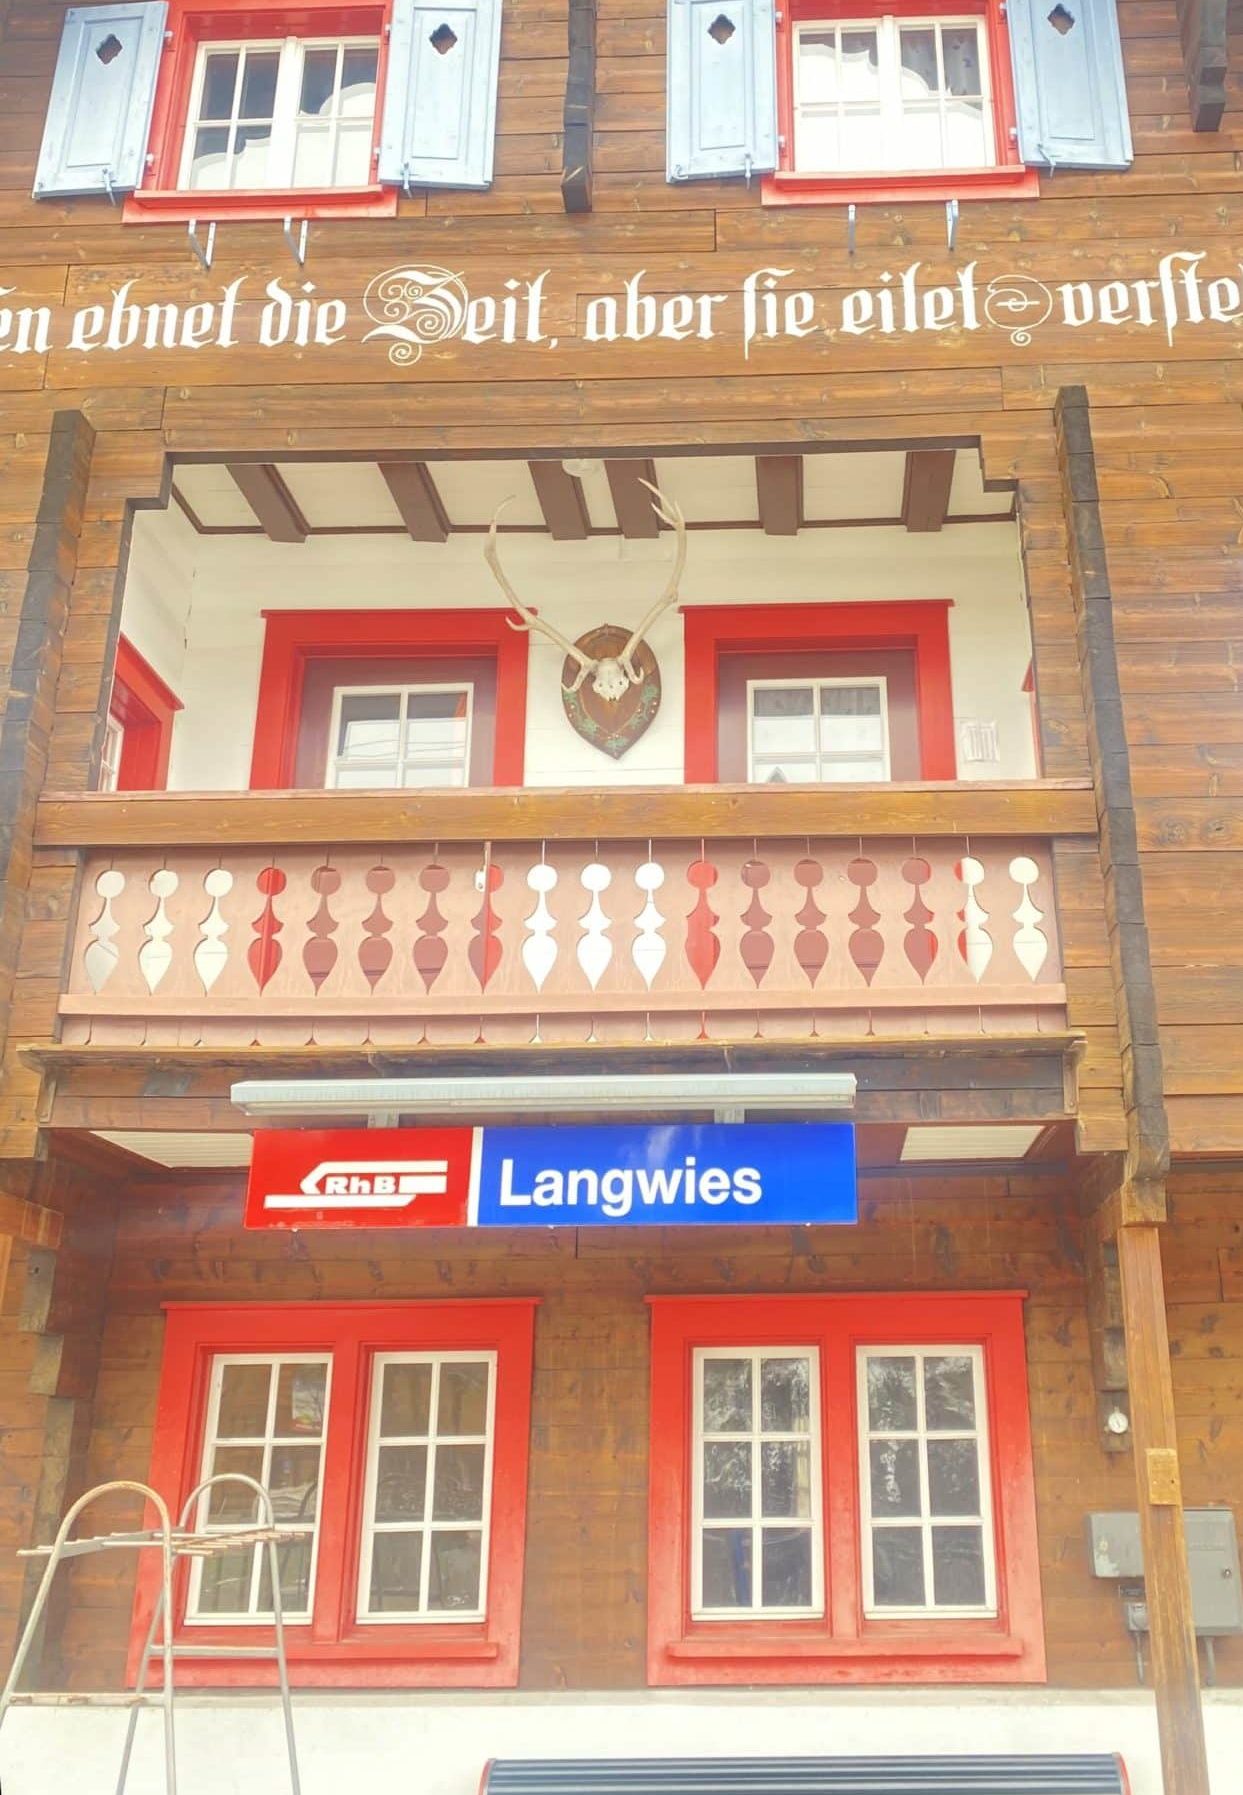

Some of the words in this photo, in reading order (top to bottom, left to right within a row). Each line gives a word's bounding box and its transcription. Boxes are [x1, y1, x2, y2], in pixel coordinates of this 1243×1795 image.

[65, 275, 249, 353] ebnet
[258, 279, 350, 350] die
[361, 265, 559, 367] Zeit,
[583, 271, 729, 344] aber
[839, 260, 983, 339] eilet
[1055, 250, 1243, 348] verste
[325, 1175, 396, 1195] RhB
[499, 1156, 763, 1217] Langwies
